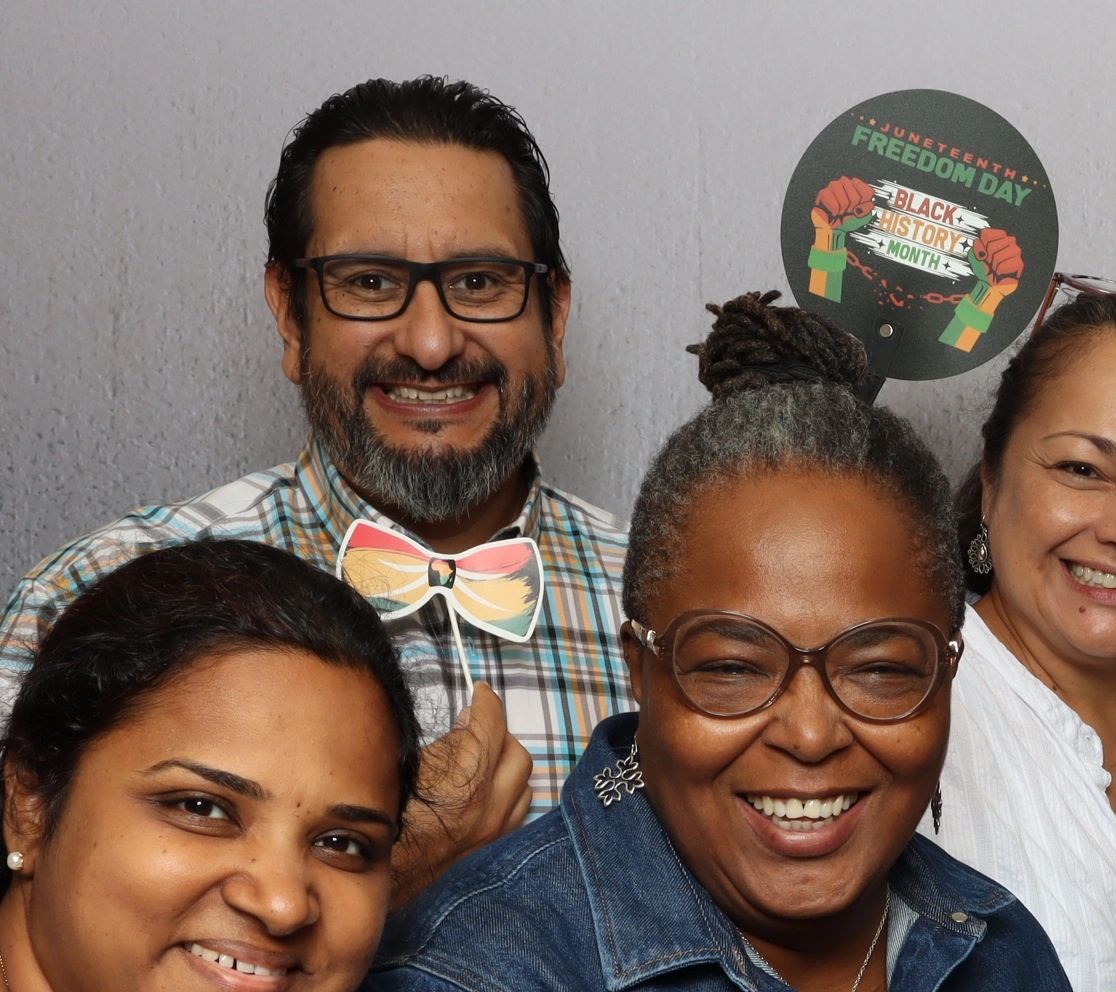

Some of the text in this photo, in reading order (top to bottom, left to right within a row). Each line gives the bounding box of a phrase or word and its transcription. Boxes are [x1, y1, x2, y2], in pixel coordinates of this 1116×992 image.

[851, 125, 1032, 207] FREEDOM DAY
[880, 123, 1017, 180] JUNETEENTH
[894, 188, 959, 225] BLACK
[879, 211, 962, 253] HISTORY
[886, 239, 941, 271] MONTH
